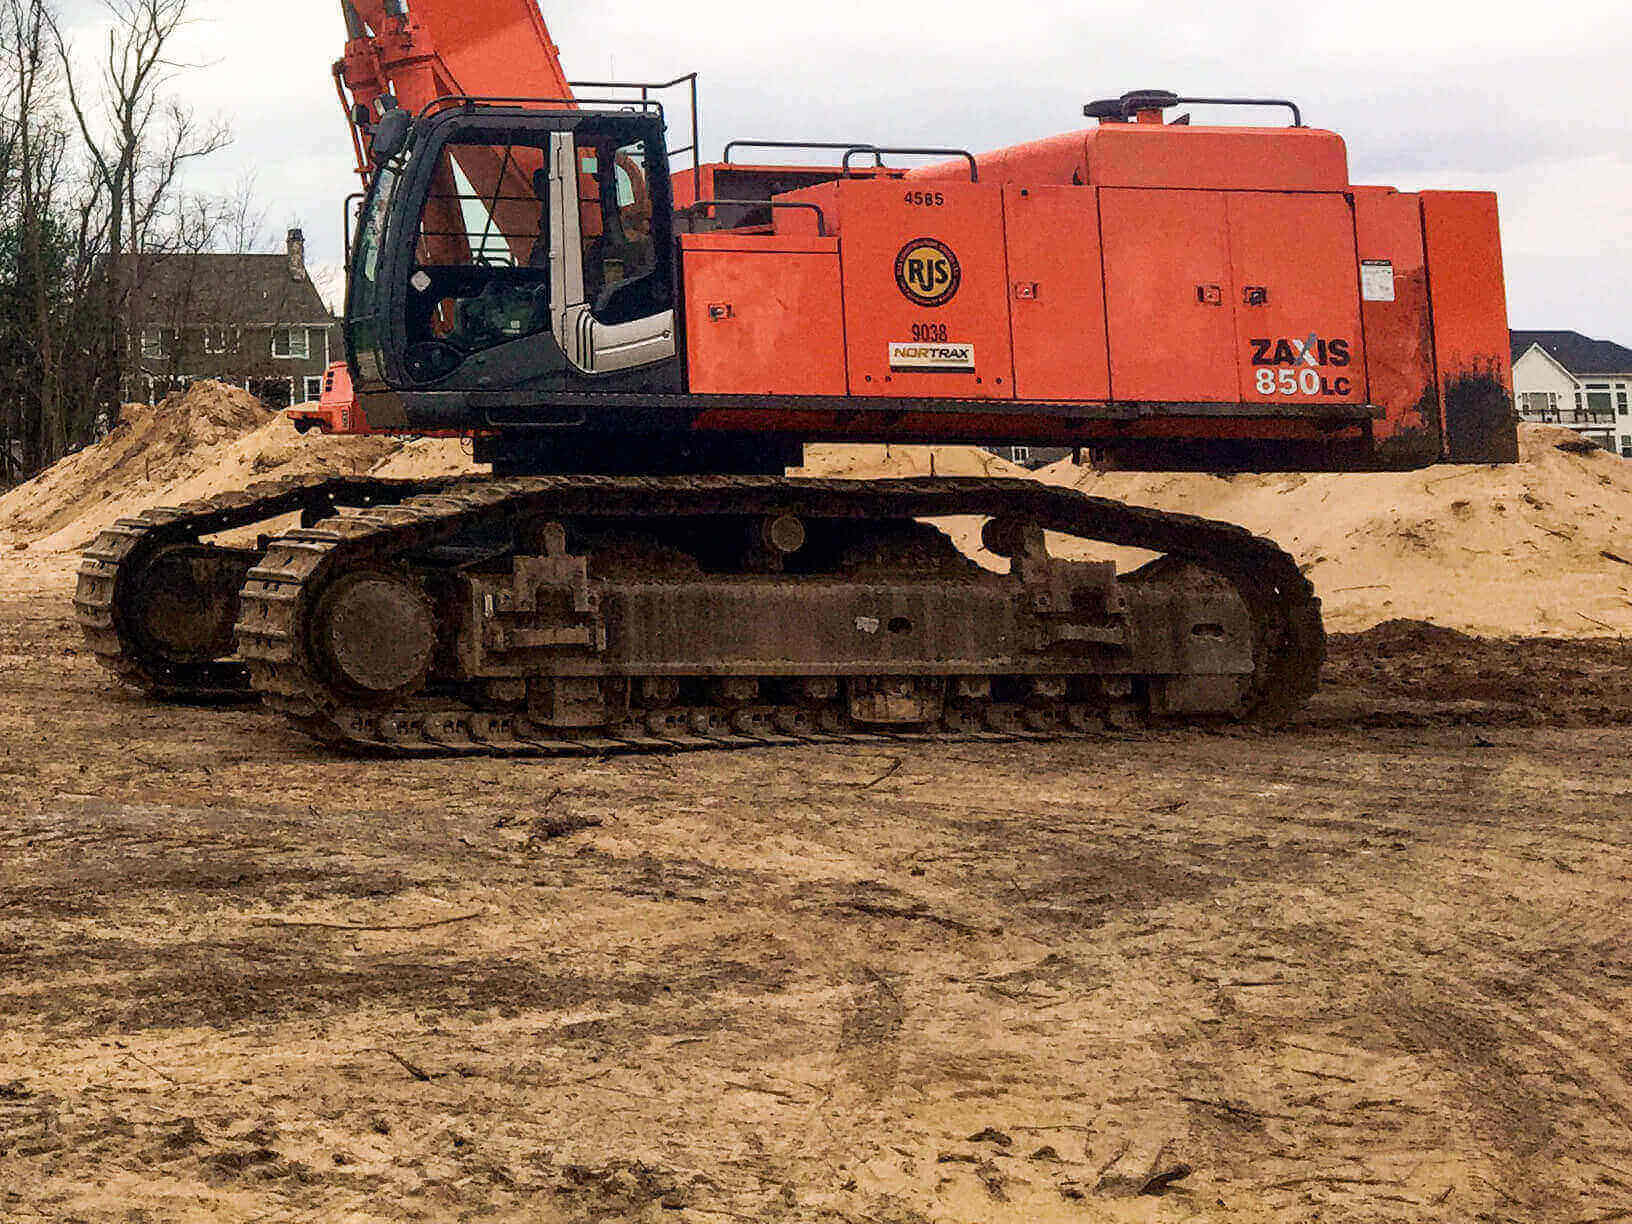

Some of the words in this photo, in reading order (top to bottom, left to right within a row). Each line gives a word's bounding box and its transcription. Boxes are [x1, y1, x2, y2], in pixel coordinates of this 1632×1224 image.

[904, 192, 944, 206] 4585
[909, 259, 948, 291] RJS
[912, 323, 948, 343] 9038
[894, 347, 969, 359] NORTRAX
[1250, 333, 1351, 367] ZAXIS
